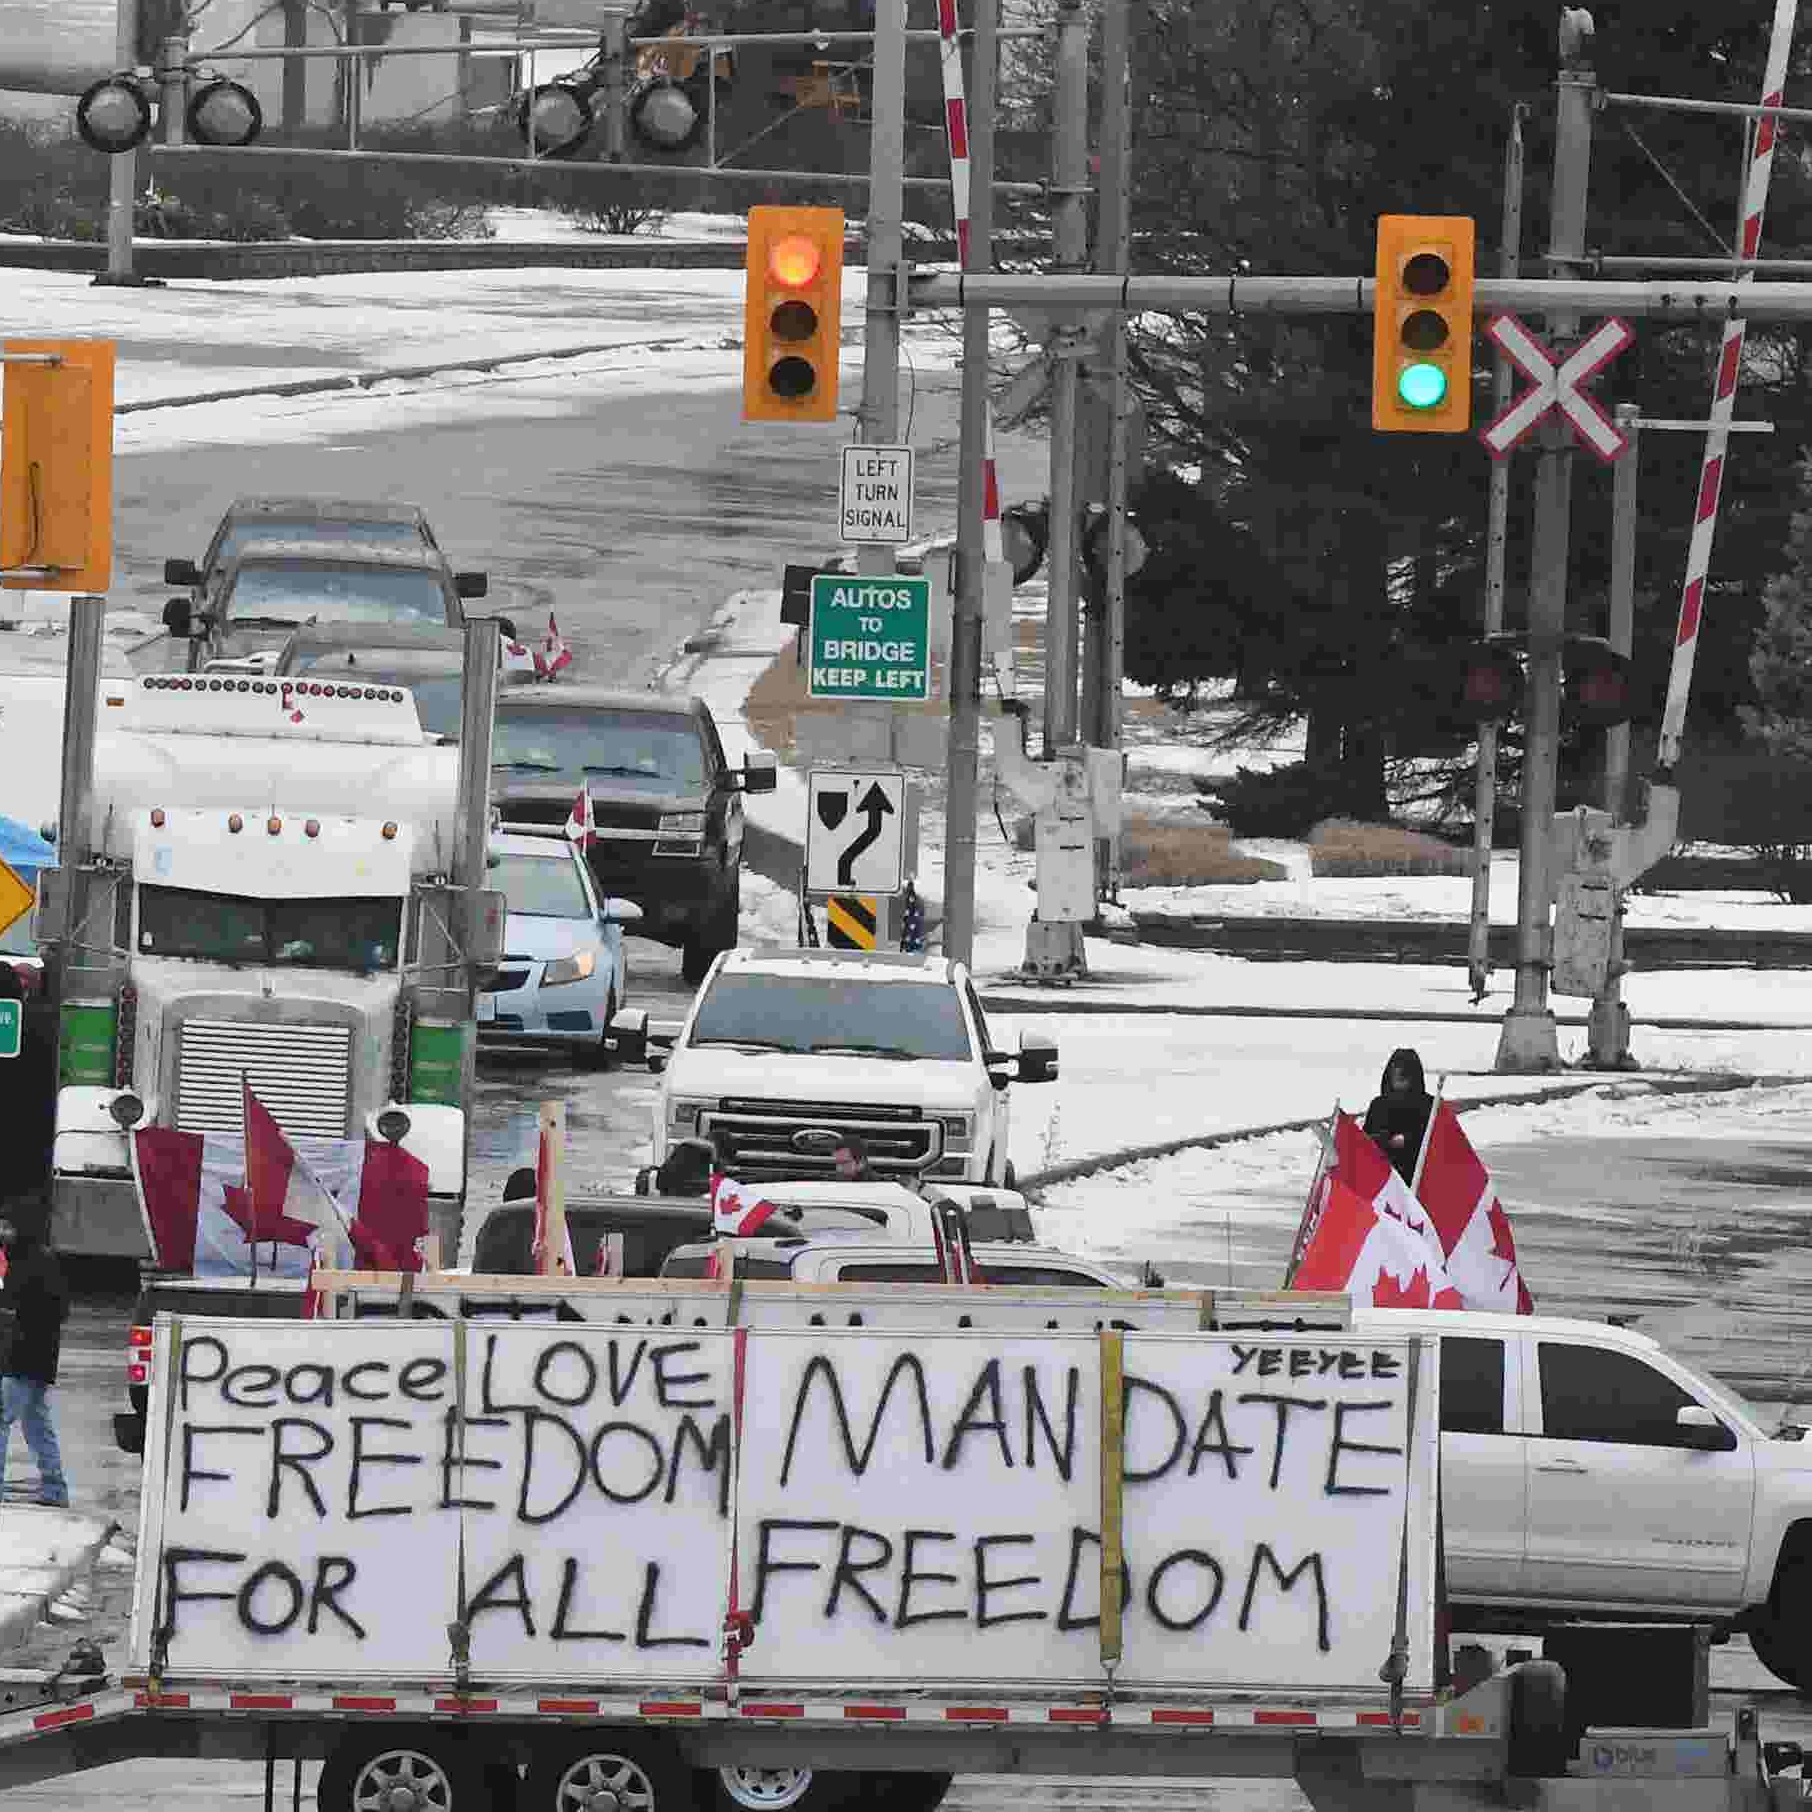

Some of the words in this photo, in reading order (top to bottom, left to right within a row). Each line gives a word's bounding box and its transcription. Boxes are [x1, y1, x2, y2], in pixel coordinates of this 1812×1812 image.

[855, 459, 898, 477] LEFT
[854, 484, 898, 501] TURN
[845, 508, 906, 528] SIGNAL
[829, 586, 912, 610] AUTOS
[858, 616, 884, 633] TO
[823, 639, 917, 662] BRIDGE
[812, 668, 868, 687] KEEP
[875, 669, 925, 689] LEFT
[1228, 1343, 1402, 1380] YEEYEE
[180, 1335, 446, 1410] Peace
[483, 1334, 716, 1414] LOVE
[780, 1352, 1402, 1495] MANDATE
[180, 1404, 731, 1524] FREEDOM
[752, 1516, 1332, 1651] FREEDOM
[162, 1547, 366, 1641] FOR
[462, 1553, 710, 1648] ALL
